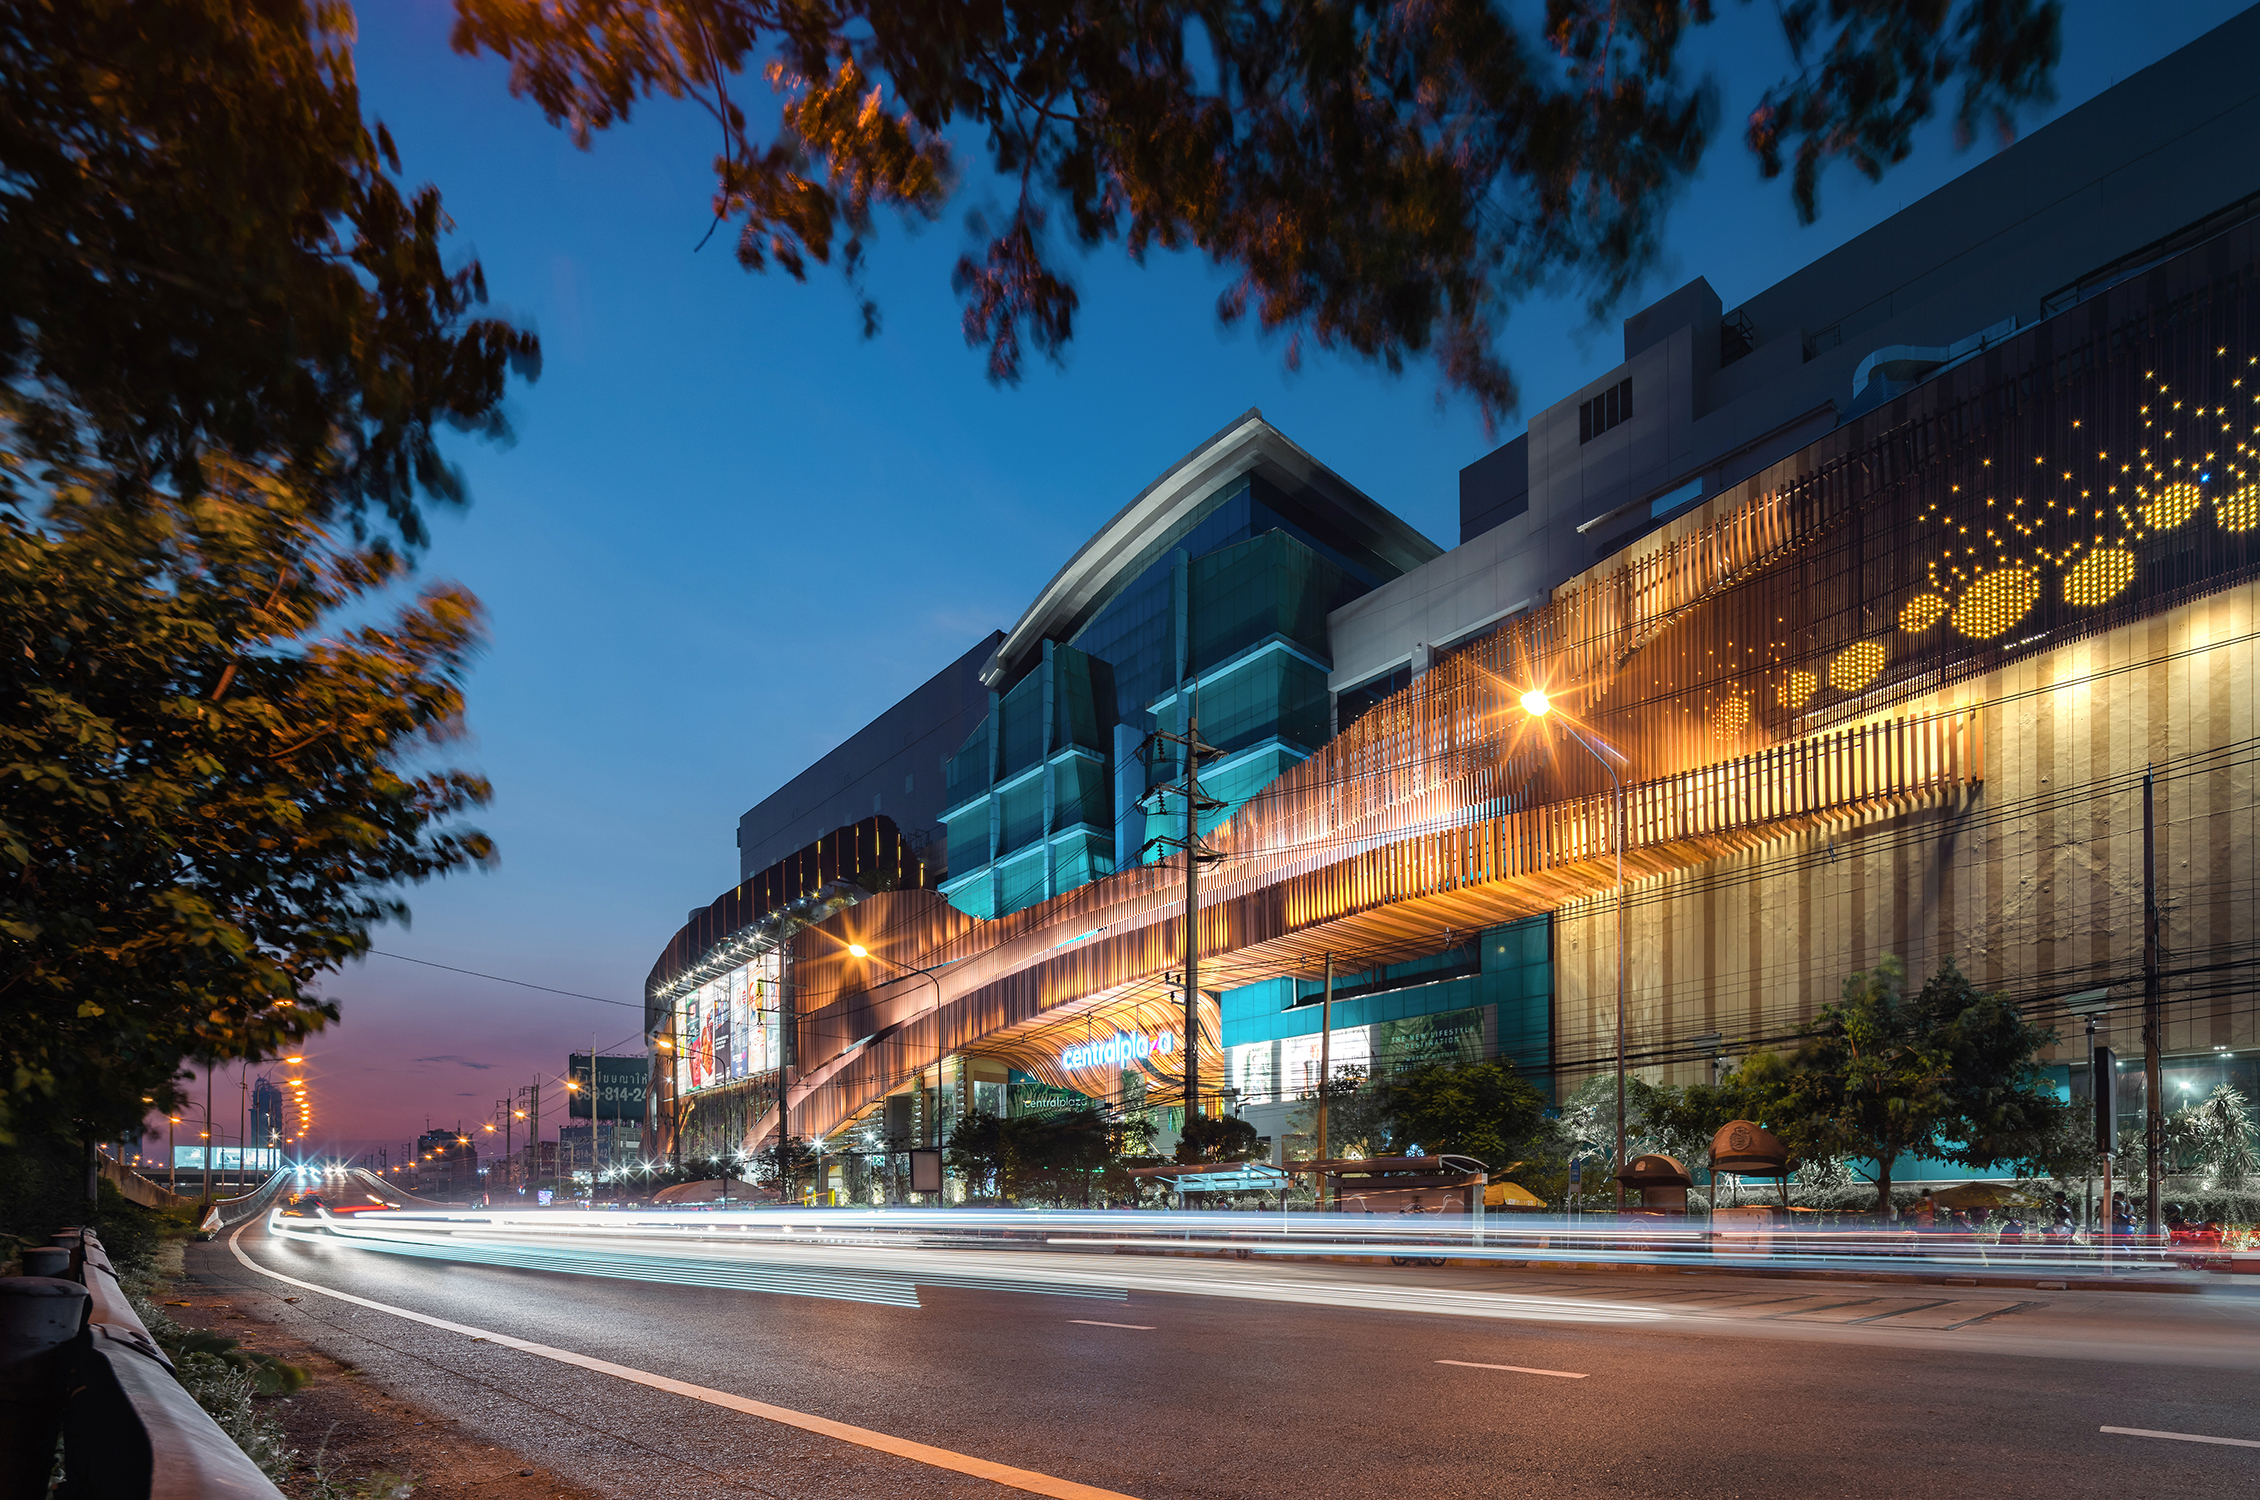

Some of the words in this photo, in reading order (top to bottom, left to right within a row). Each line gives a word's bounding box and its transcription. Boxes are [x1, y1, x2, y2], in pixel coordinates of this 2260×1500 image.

[1391, 1035, 1405, 1044] THE
[1409, 1032, 1426, 1041] NEW
[1430, 1025, 1474, 1038] LIFESTYLE
[1062, 1030, 1173, 1069] centralplaza
[1405, 1037, 1459, 1049] DESTINATION
[1024, 1097, 1087, 1110] centralplaza
